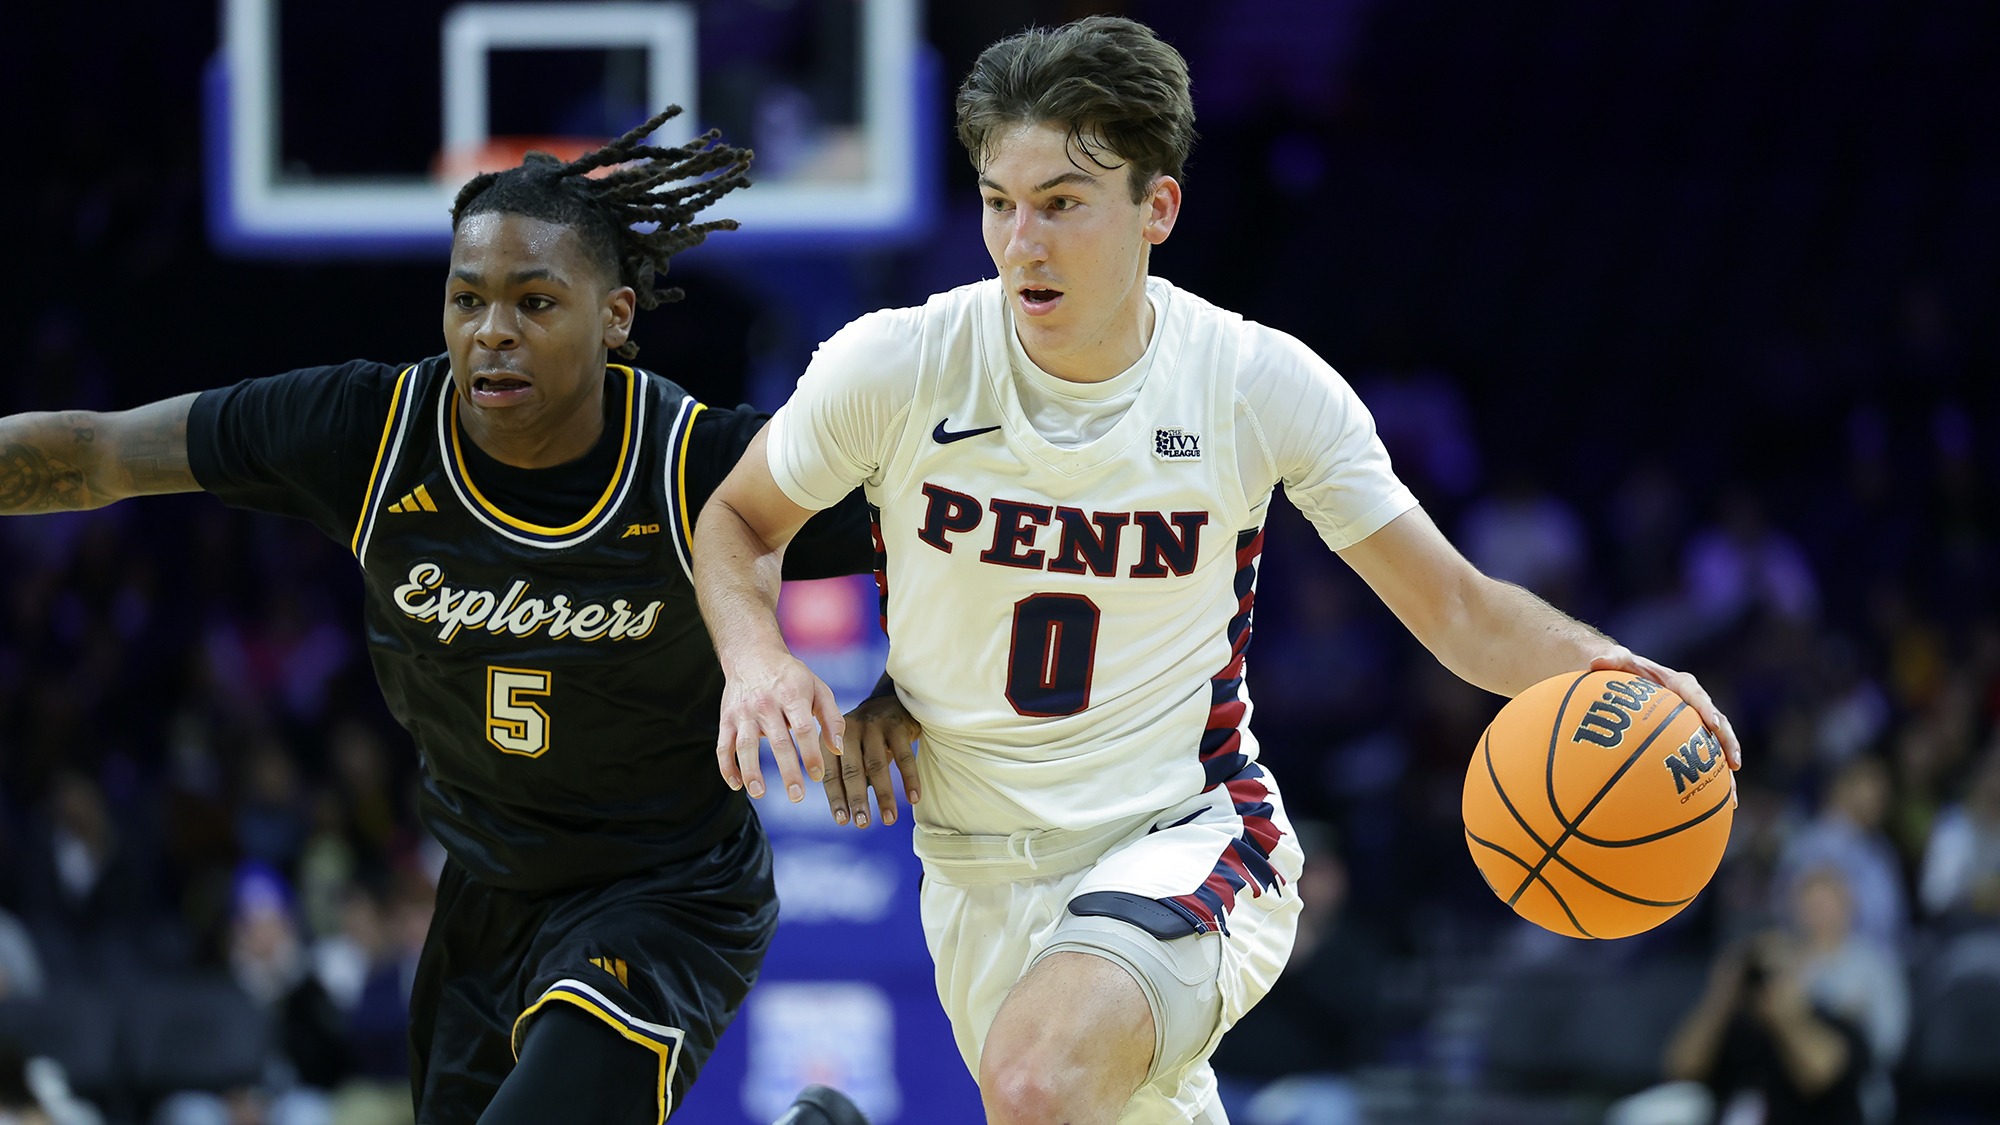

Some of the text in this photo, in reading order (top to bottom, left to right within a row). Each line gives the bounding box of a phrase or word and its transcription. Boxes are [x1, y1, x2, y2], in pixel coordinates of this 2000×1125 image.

[1168, 435, 1200, 450] IVY
[1169, 449, 1201, 458] LEAGUE
[621, 523, 660, 539] A10
[918, 481, 1209, 579] PENN
[393, 562, 665, 645] Explorers
[1004, 592, 1101, 718] 0
[486, 665, 552, 759] 5
[1571, 675, 1664, 750] Wils
[1663, 725, 1723, 796] NCA
[1680, 777, 1714, 805] OFFICIAL
